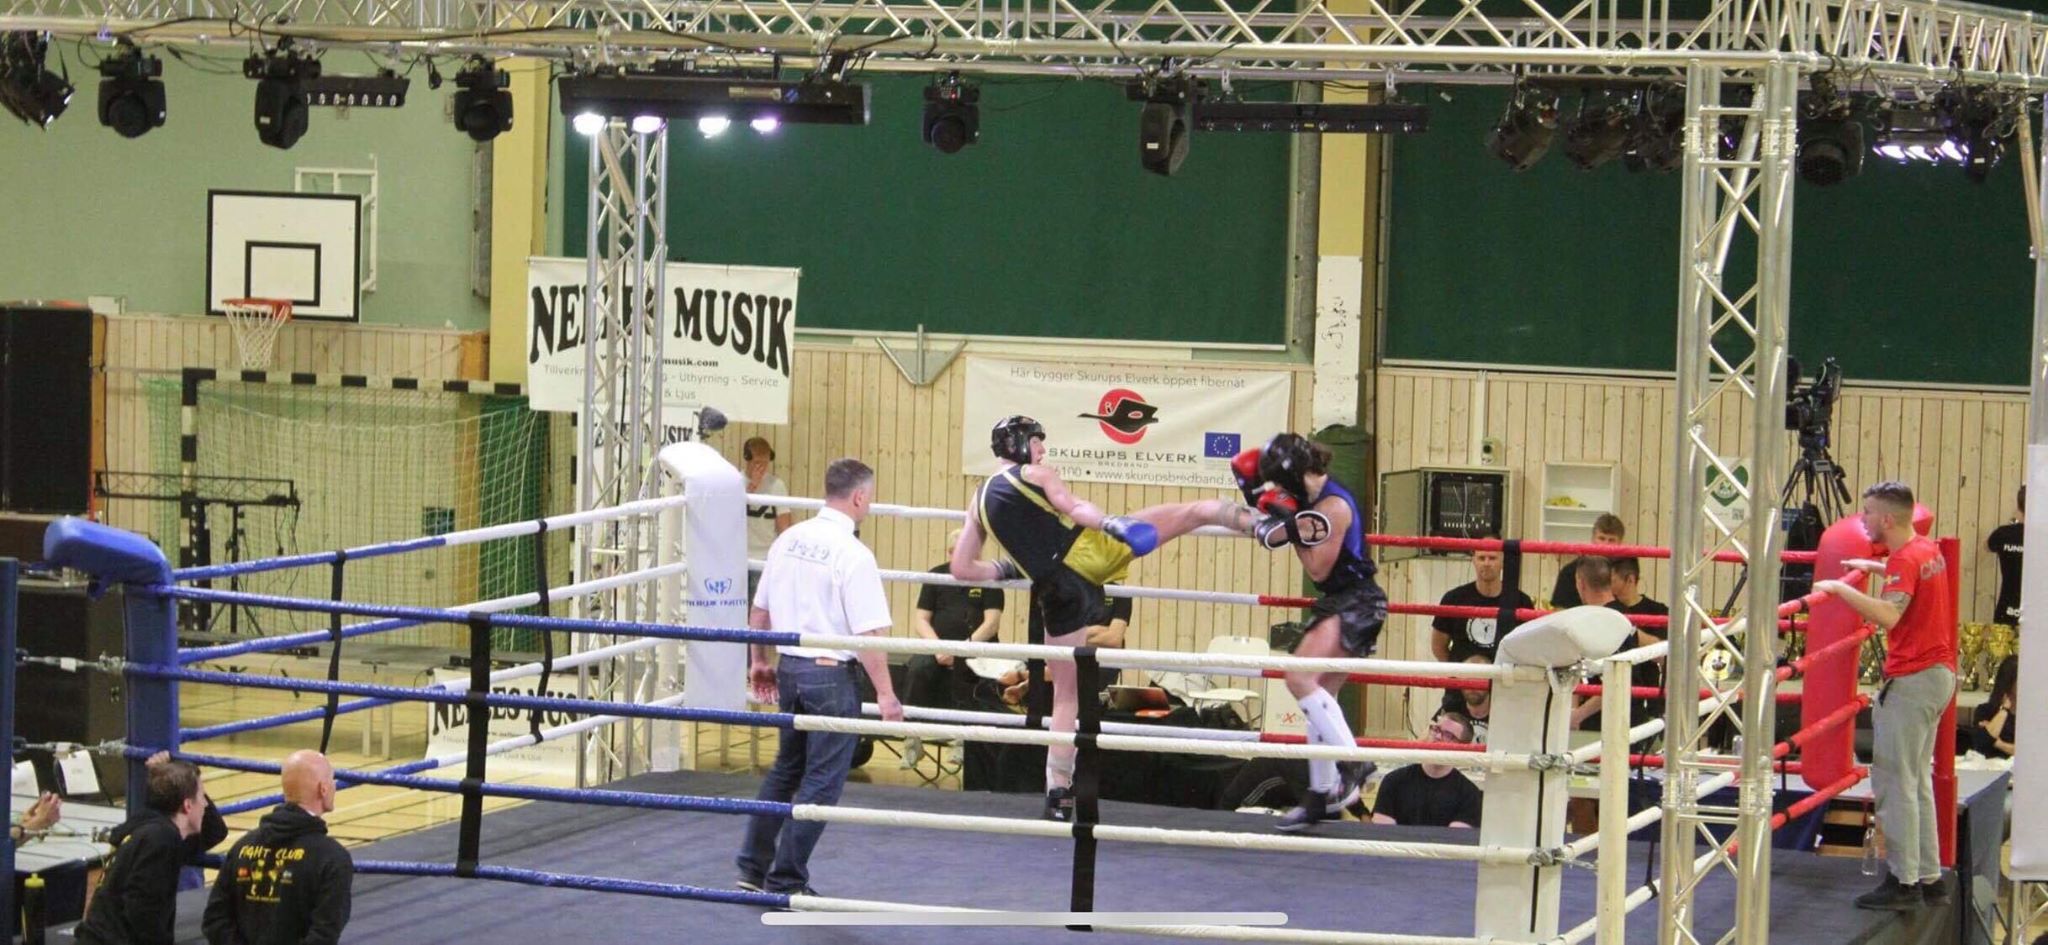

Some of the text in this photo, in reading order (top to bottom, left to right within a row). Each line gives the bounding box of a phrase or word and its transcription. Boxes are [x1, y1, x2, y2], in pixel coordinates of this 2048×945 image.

[530, 284, 792, 378] NEES MUSIK
[680, 372, 729, 385] Uthyrning
[741, 375, 778, 387] Service
[1010, 366, 1030, 377] Här
[1034, 367, 1074, 382] bygger
[1077, 370, 1121, 385] Skurups
[1125, 373, 1159, 384] Elverk
[675, 388, 696, 400] Ljus
[1048, 447, 1198, 463] SKURUPS ELVERK
[239, 845, 305, 861] FIGHT CLUB
